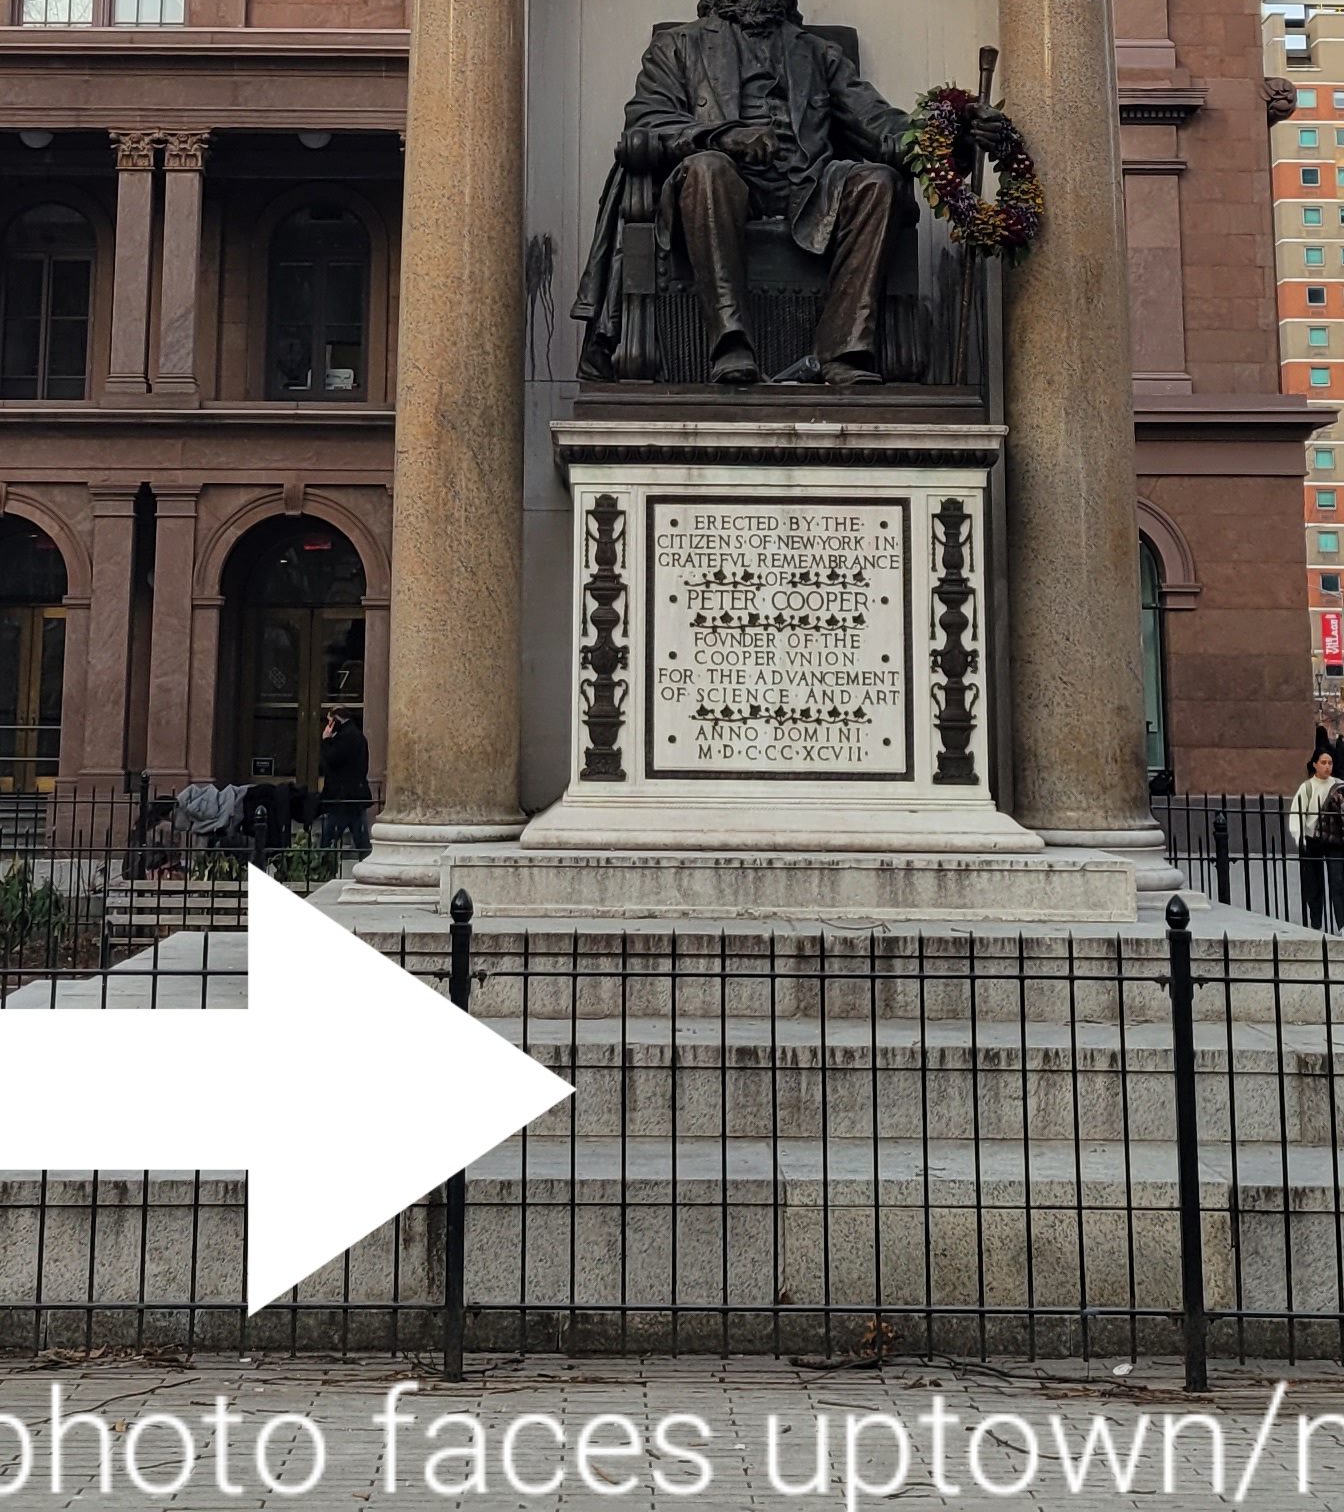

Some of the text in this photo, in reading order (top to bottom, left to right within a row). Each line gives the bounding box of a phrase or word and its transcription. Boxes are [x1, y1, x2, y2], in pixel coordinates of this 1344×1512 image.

[694, 515, 861, 532] ERECTED BY THE
[657, 535, 896, 551] CITIZENS OF NEW YORK IN
[757, 553, 900, 570] REMEMBRANCE
[765, 571, 788, 587] OF
[687, 590, 870, 612] PETER COOPER
[694, 632, 861, 649] FOVNDER OF THE
[694, 650, 856, 667] COOPER VNION
[337, 670, 350, 689] 7
[658, 669, 900, 687] FOR THE ADVANCEMENT
[660, 687, 900, 706] OF SCIENCE AND ART
[695, 725, 862, 743] ANNO DOMINI
